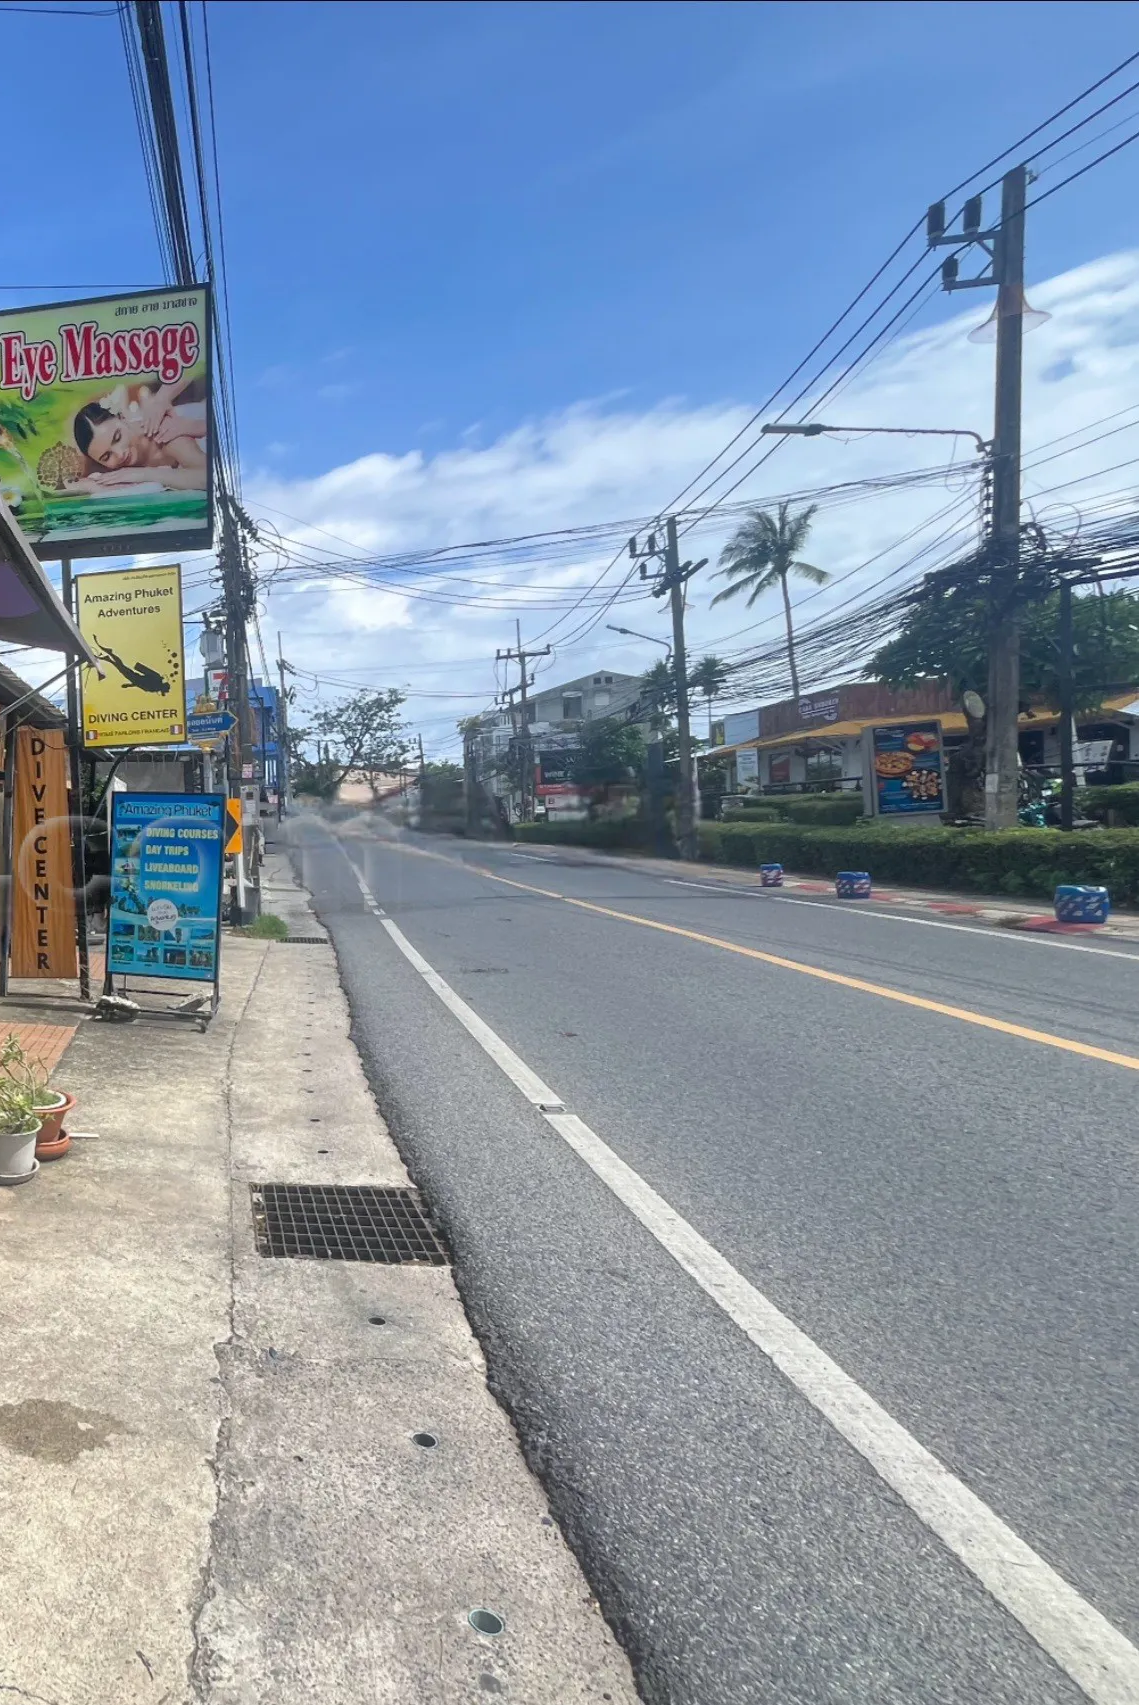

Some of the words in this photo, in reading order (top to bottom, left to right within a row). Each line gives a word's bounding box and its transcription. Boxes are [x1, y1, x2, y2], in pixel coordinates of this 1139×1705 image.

[0, 331, 56, 400] Eye
[62, 322, 199, 384] Massage
[84, 591, 132, 604] Amazing
[134, 586, 174, 599] Phuket
[97, 605, 161, 618] Adventures
[88, 712, 128, 724] DIVING
[131, 709, 178, 721] CENTER
[125, 803, 172, 817] Amazing
[174, 804, 212, 817] Phuket
[146, 828, 175, 839] DIVING
[177, 828, 219, 840] COURSES
[145, 845, 162, 855] DAY
[164, 845, 189, 856] TRIPS
[144, 863, 199, 874] LIVEABOARD
[144, 880, 199, 893] SNORKELING
